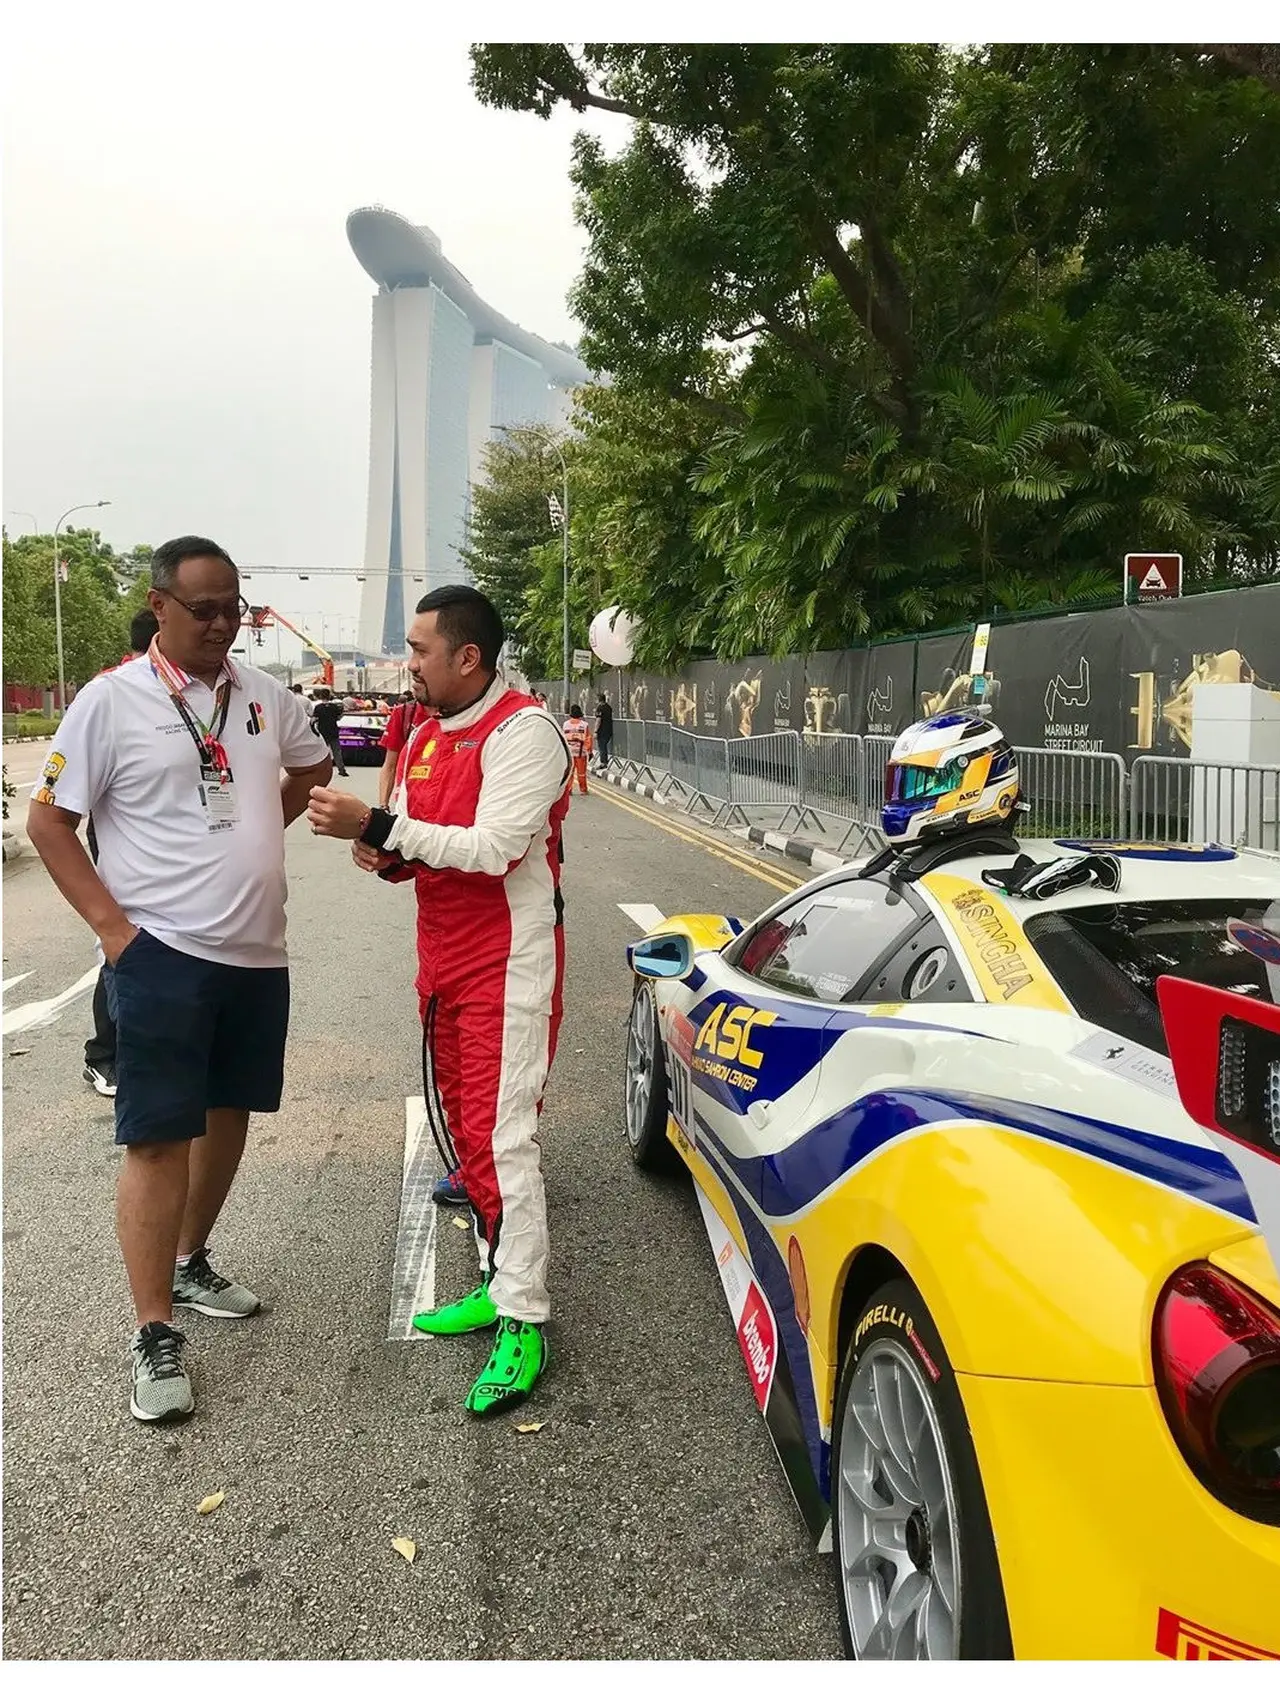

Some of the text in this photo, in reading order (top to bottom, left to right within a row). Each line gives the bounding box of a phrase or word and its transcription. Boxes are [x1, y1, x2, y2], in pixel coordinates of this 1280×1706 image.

[1044, 723, 1090, 737] MARINA BAY
[1044, 738, 1104, 752] STREET CIRCUIT
[958, 789, 980, 802] ASC
[960, 903, 1034, 1001] SINGHA
[694, 1002, 780, 1069] ASC
[728, 1069, 758, 1093] CENTER
[1136, 1060, 1175, 1081] FERRAR
[855, 1304, 906, 1347] PIRELLI
[742, 1309, 771, 1385] brembo
